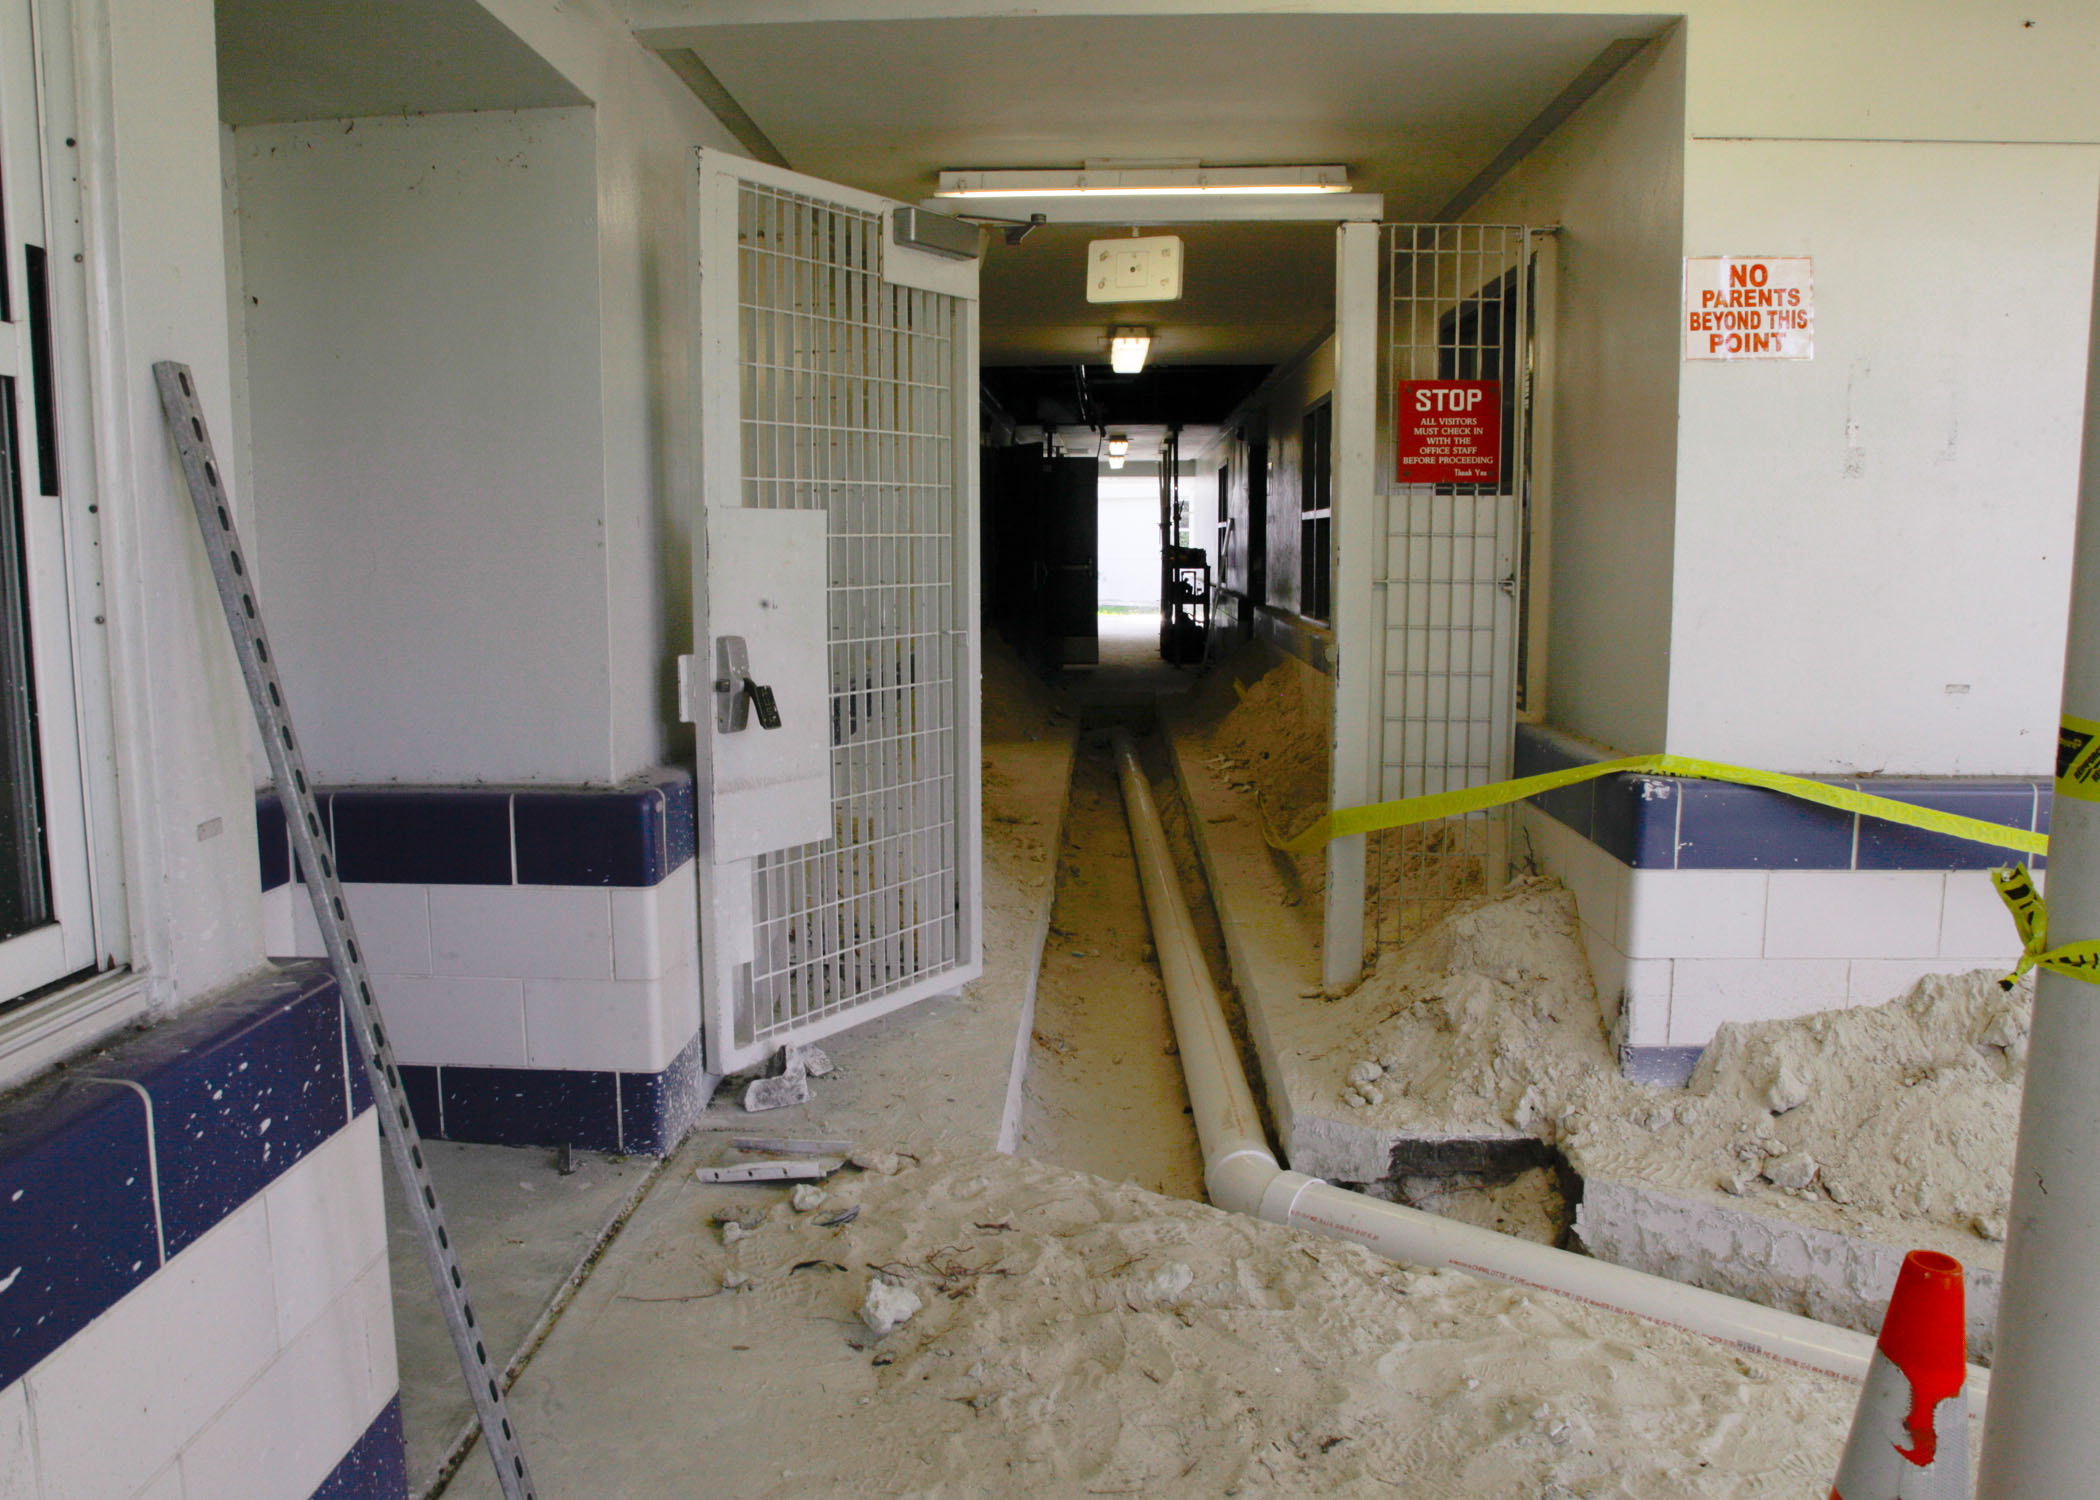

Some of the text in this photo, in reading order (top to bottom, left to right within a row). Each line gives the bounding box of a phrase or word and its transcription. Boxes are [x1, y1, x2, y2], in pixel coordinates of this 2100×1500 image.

[1730, 263, 1768, 288] NO
[1702, 288, 1801, 309] PARENTS
[1690, 309, 1808, 332] BEYOND THIS
[1709, 332, 1787, 354] POINT
[1415, 389, 1482, 412] STOP
[1420, 417, 1478, 426] ALL VISITORS
[1413, 427, 1484, 435] MUST CHECK IN
[1426, 437, 1471, 445] WITH THE
[1419, 446, 1478, 455] OFFICE STAFF
[1403, 456, 1494, 465] BEFORE PROCEEDING
[1454, 468, 1487, 477] Thank You
